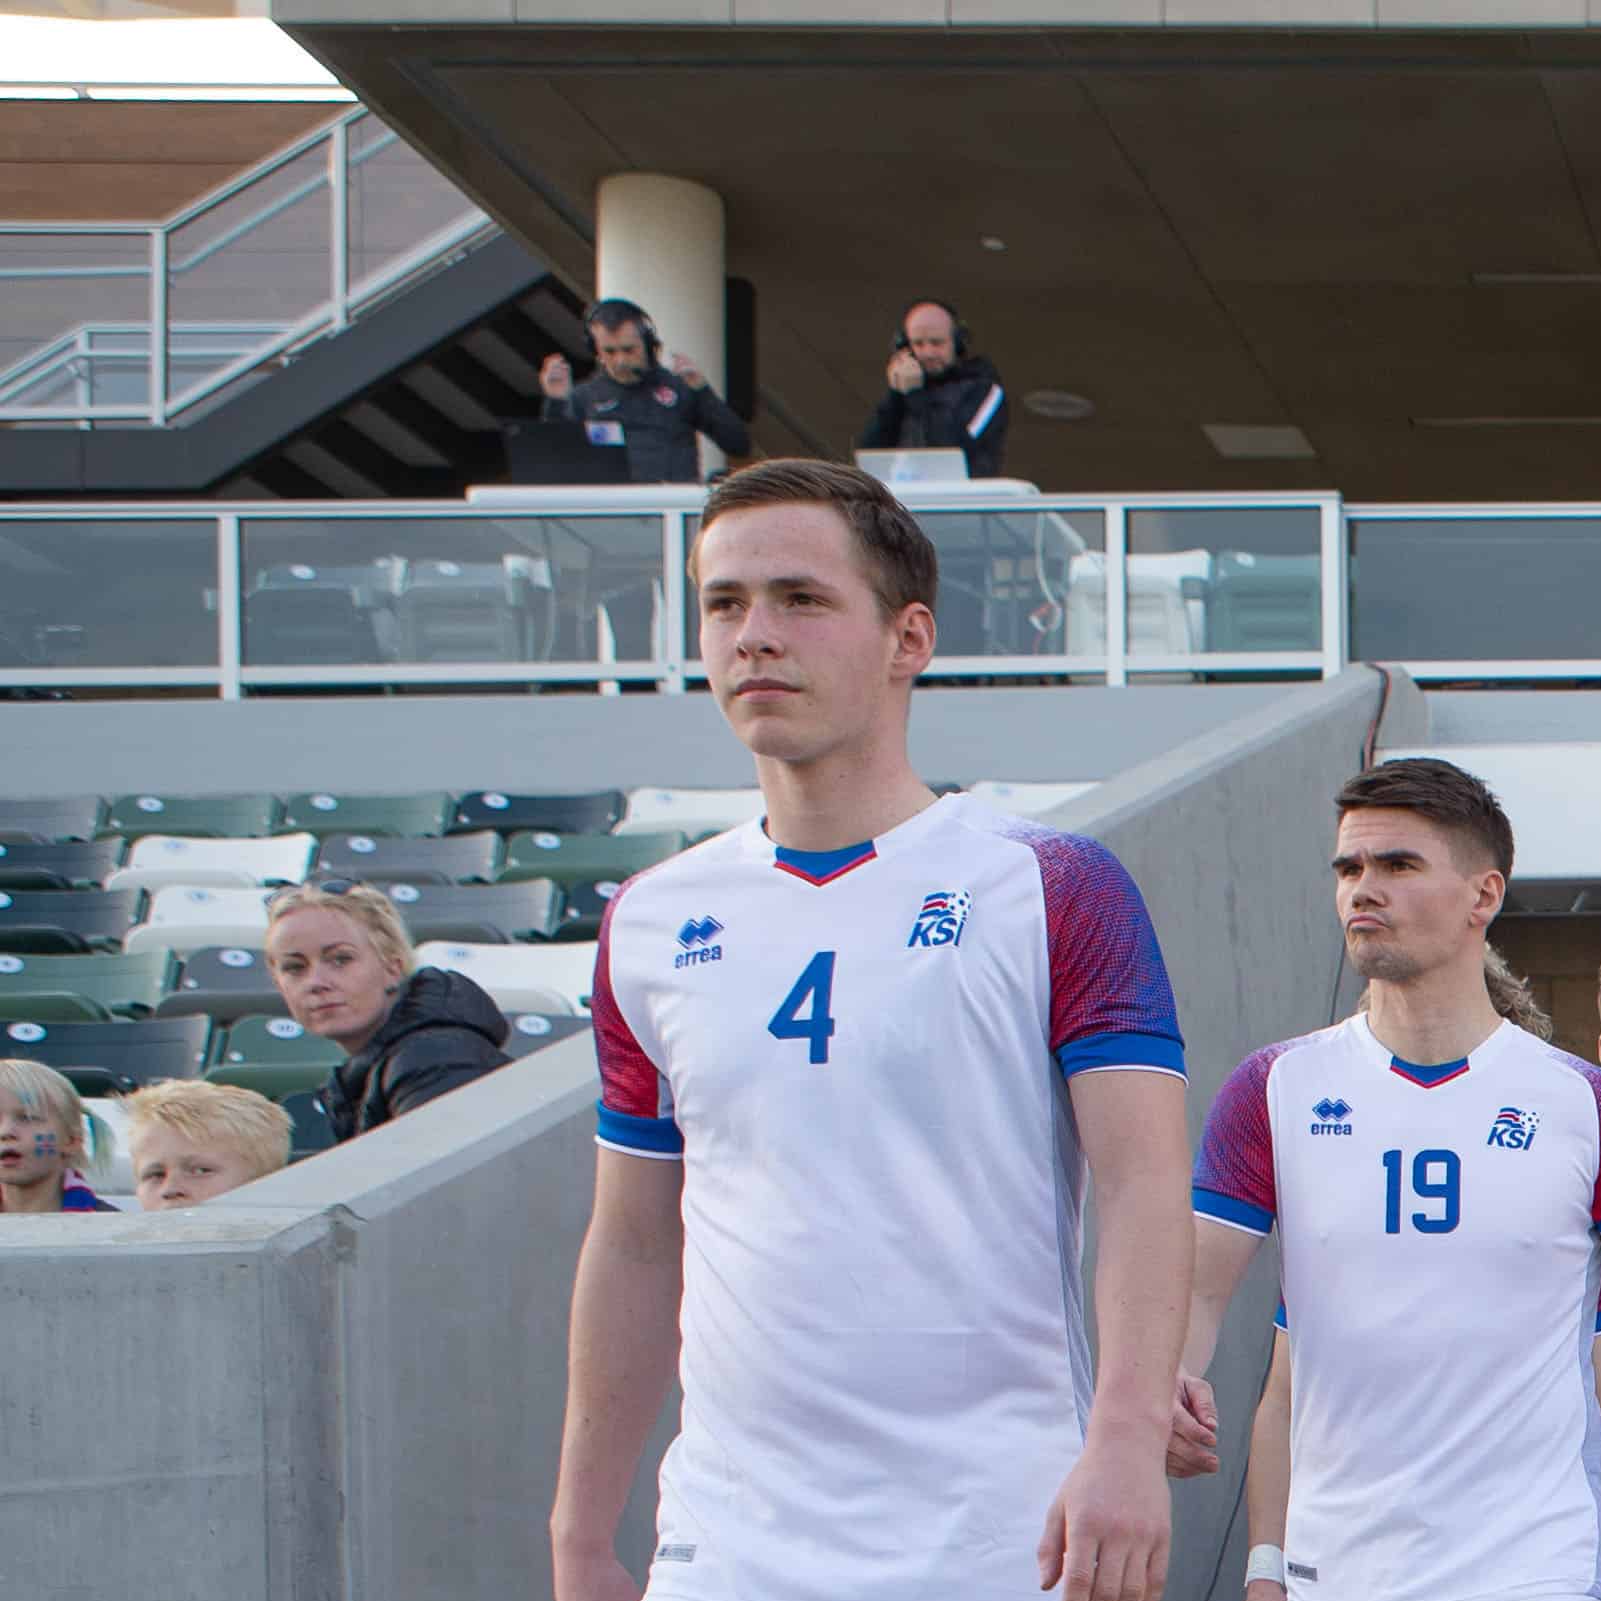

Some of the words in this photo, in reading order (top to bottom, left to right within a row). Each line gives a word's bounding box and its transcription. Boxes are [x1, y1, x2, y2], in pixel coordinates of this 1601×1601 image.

[674, 944, 722, 969] errea
[767, 950, 837, 1065] 4
[1311, 1123, 1352, 1135] errea
[1381, 1148, 1462, 1235] 19
